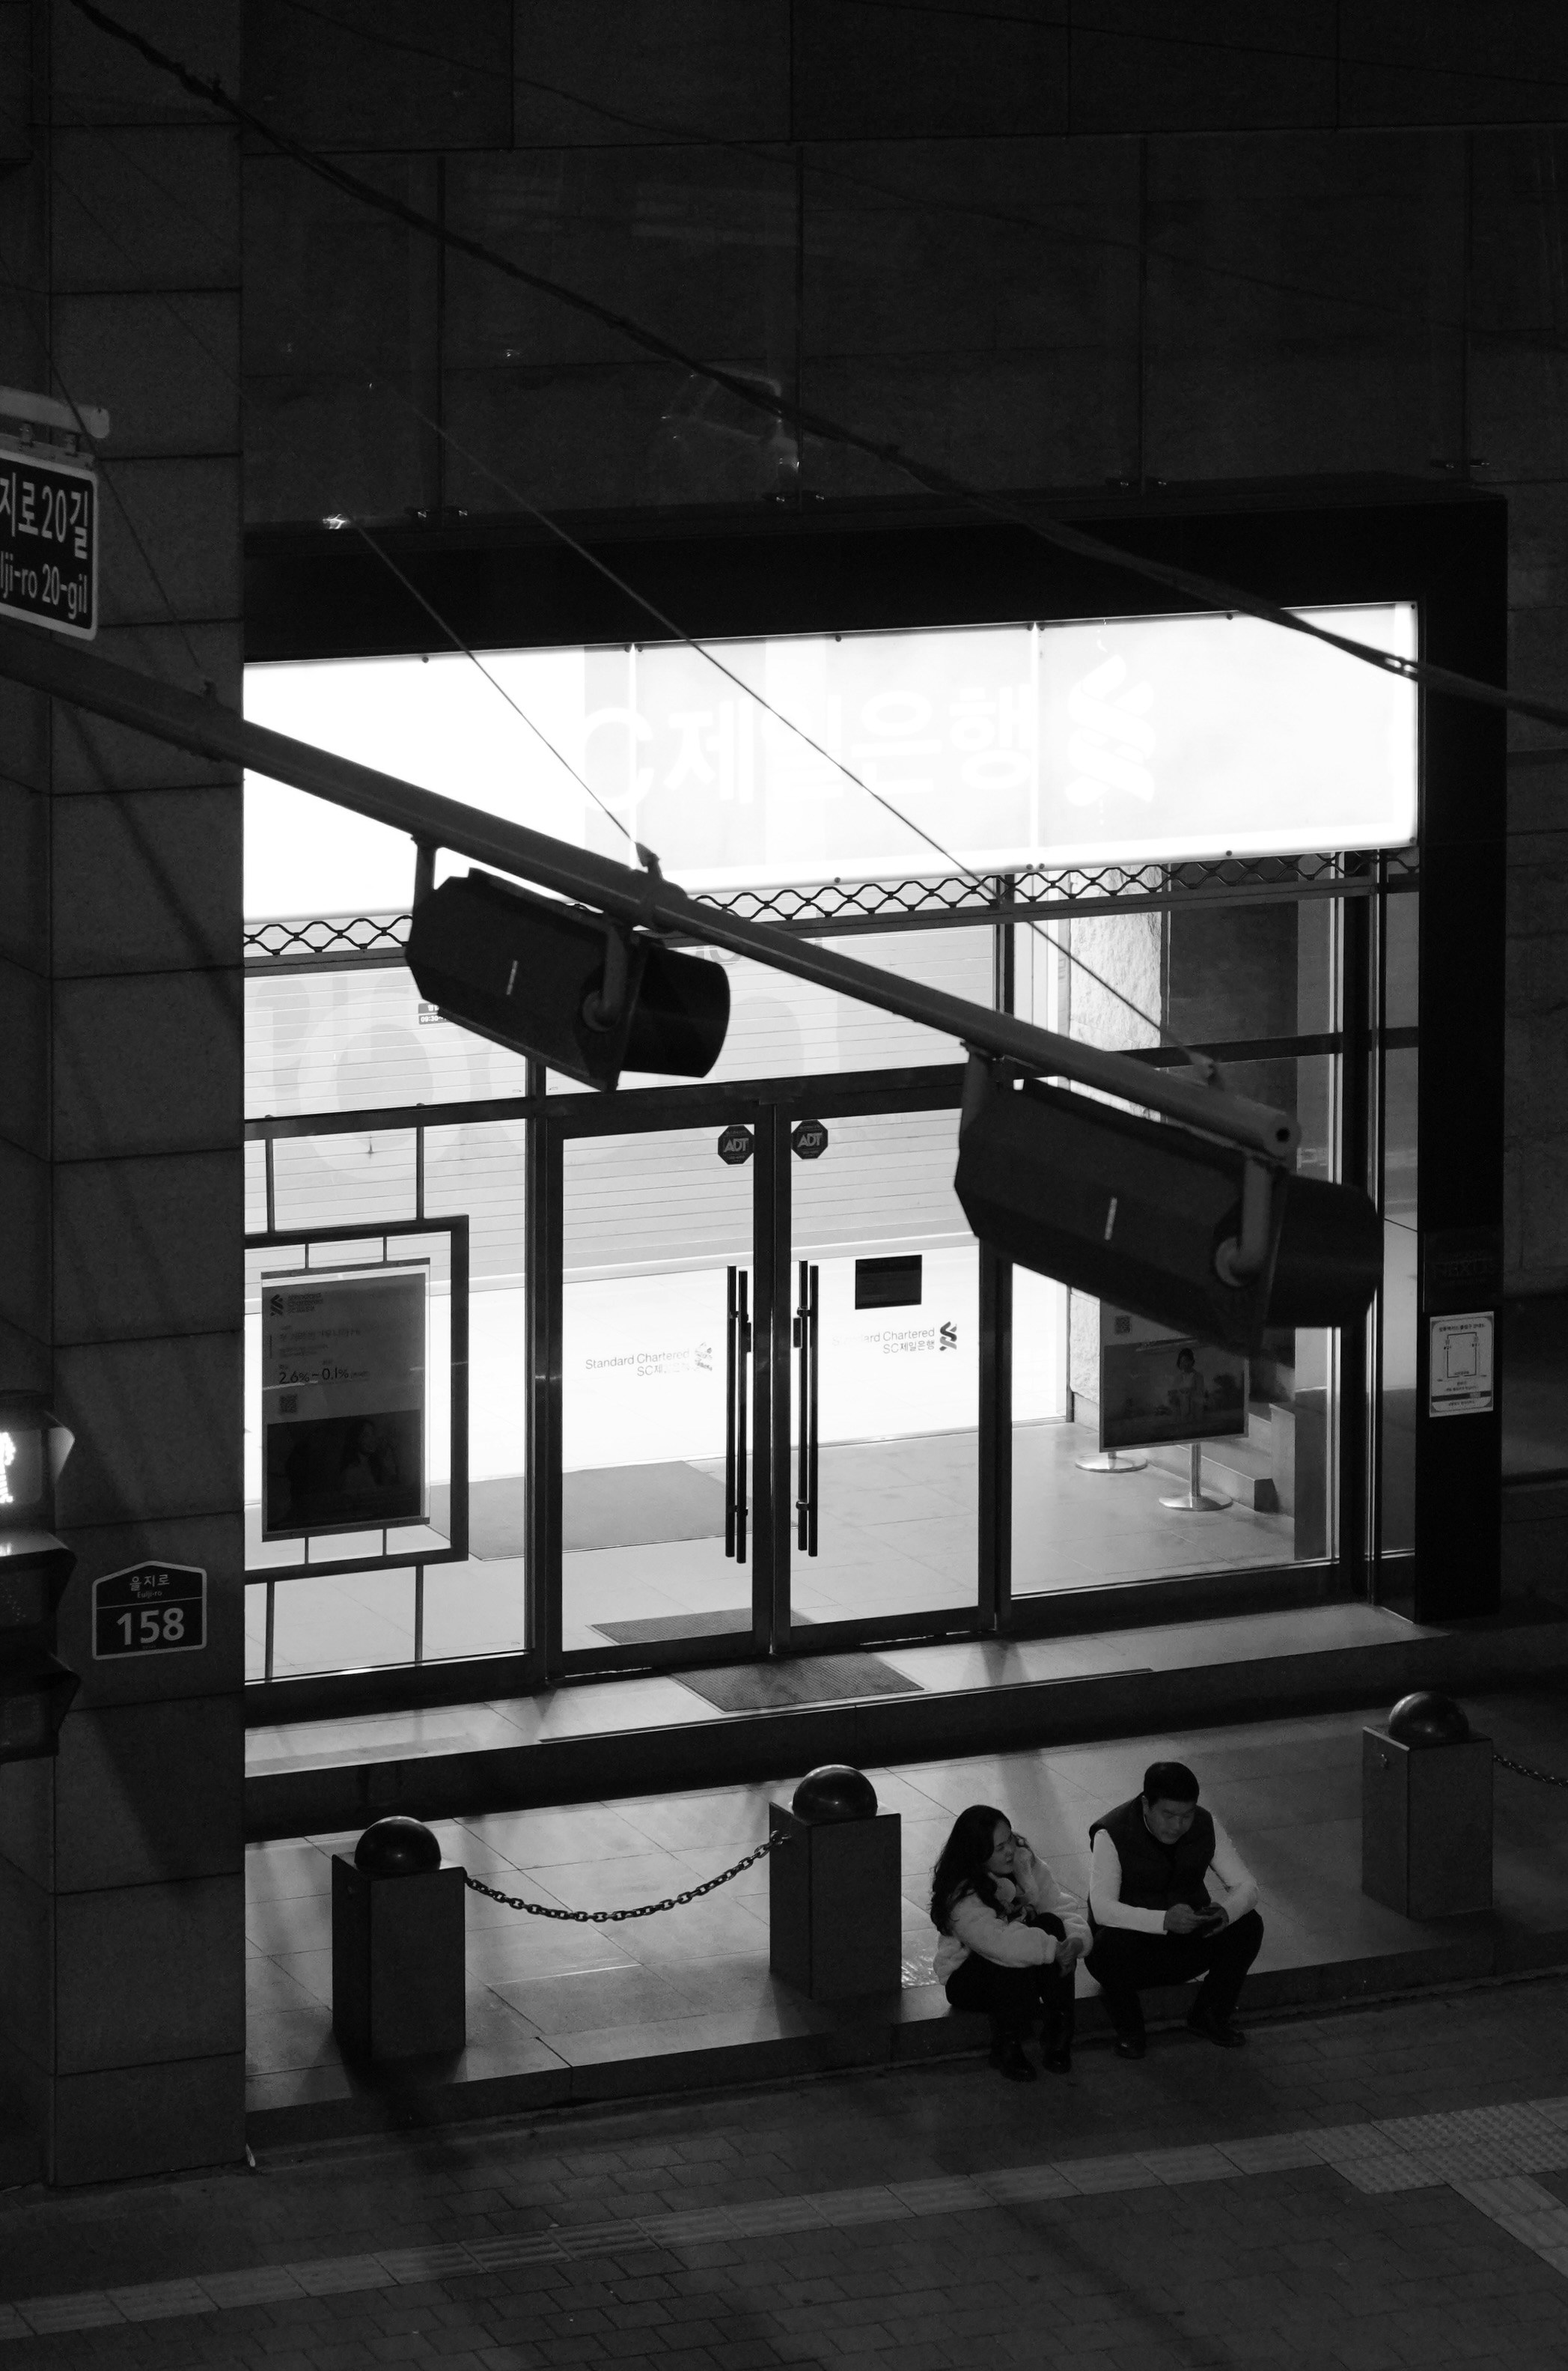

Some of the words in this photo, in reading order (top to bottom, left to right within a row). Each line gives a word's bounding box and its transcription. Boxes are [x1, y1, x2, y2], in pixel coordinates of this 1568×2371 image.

[43, 563, 88, 620] 20-gil
[723, 1137, 748, 1152] ADT
[797, 1132, 823, 1148] ADT
[882, 1327, 935, 1342] Chartered
[882, 1339, 935, 1354] SC제일은행
[585, 1355, 635, 1370] Standard
[636, 1348, 690, 1364] Chartered
[129, 1574, 170, 1592] 을지로
[116, 1607, 185, 1646] 158
